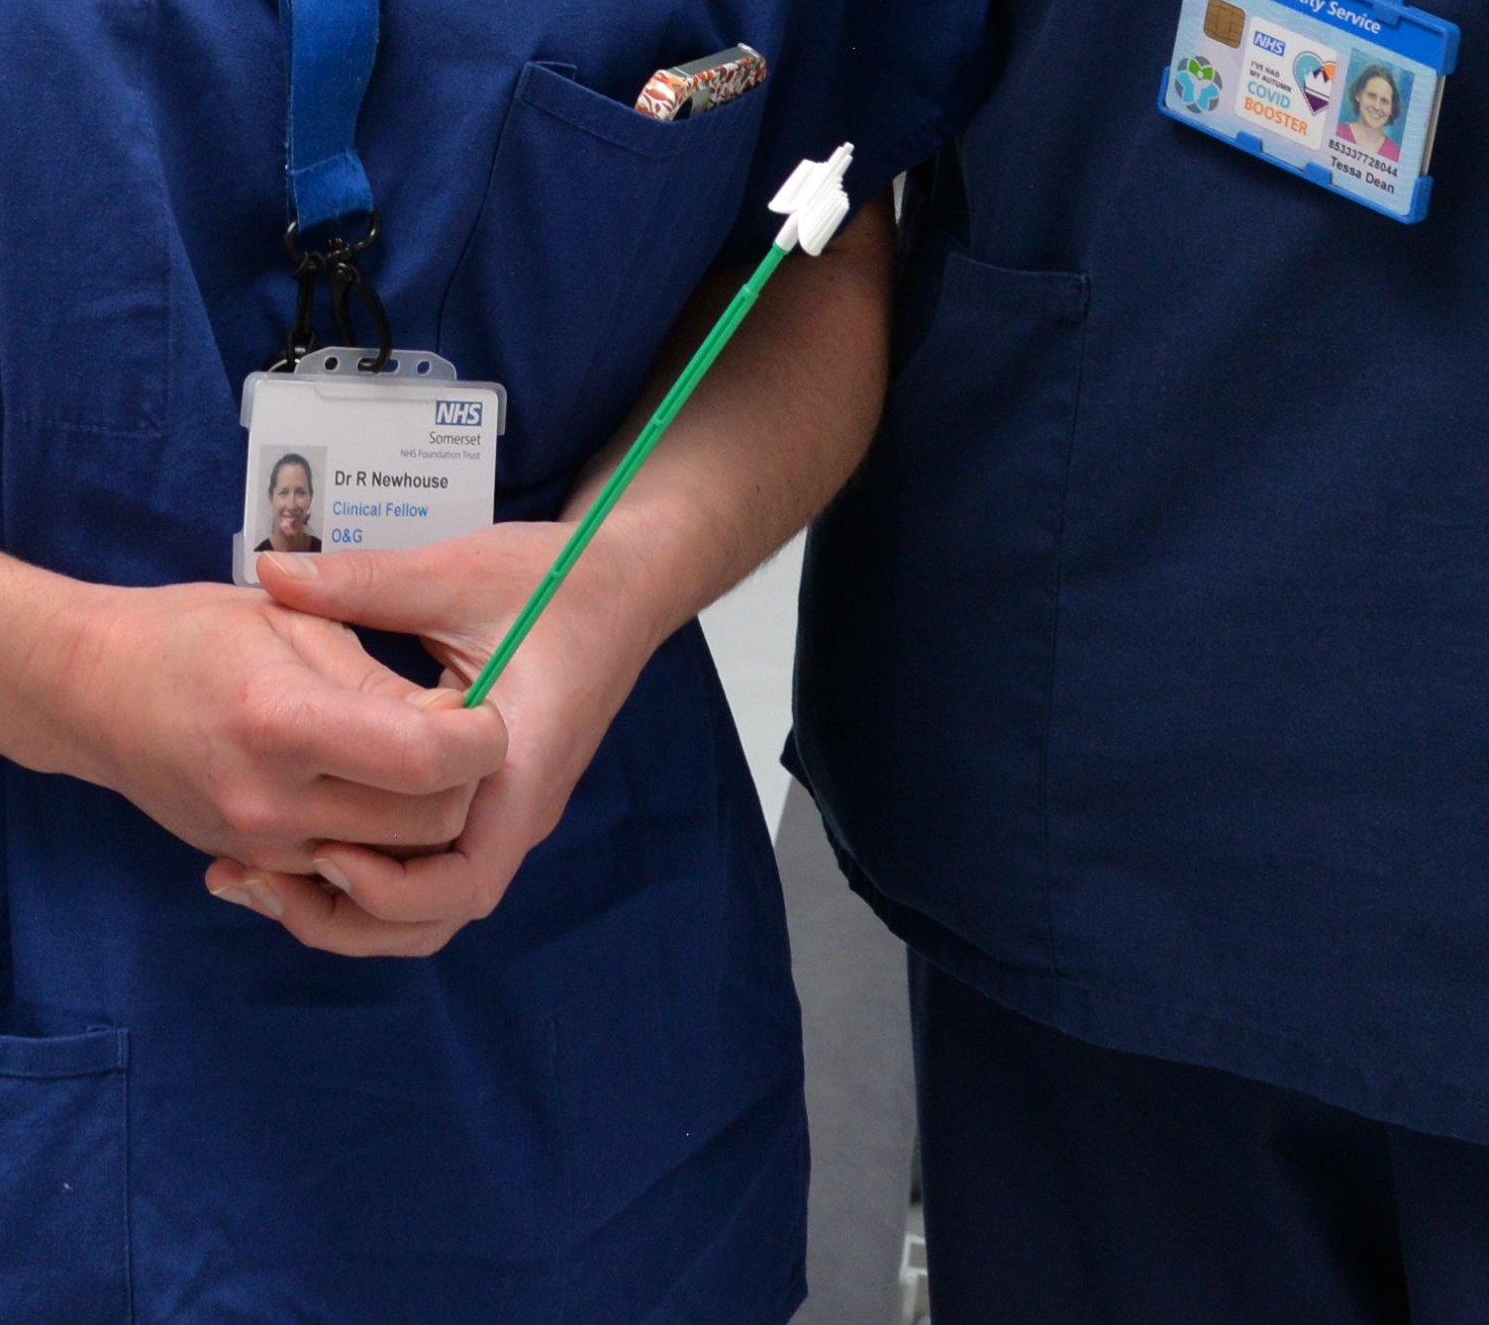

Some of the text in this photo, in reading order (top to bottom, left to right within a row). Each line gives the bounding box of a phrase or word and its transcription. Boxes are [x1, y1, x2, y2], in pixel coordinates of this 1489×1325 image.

[1327, 1, 1381, 34] Service
[1253, 31, 1285, 56] NHS
[1249, 69, 1292, 93] MY AUTUMN
[1265, 66, 1280, 78] HAD
[1247, 81, 1291, 109] COVID
[1244, 97, 1308, 136] BOOSTER
[1331, 155, 1395, 195] Tessa Dean
[436, 401, 482, 425] NHS
[429, 431, 481, 446] Somerset
[400, 449, 480, 460] NHS Foundation Trust
[334, 471, 449, 489] Dr R Newhouse
[333, 501, 429, 517] Clinical Fellow
[331, 528, 363, 543] O&G
